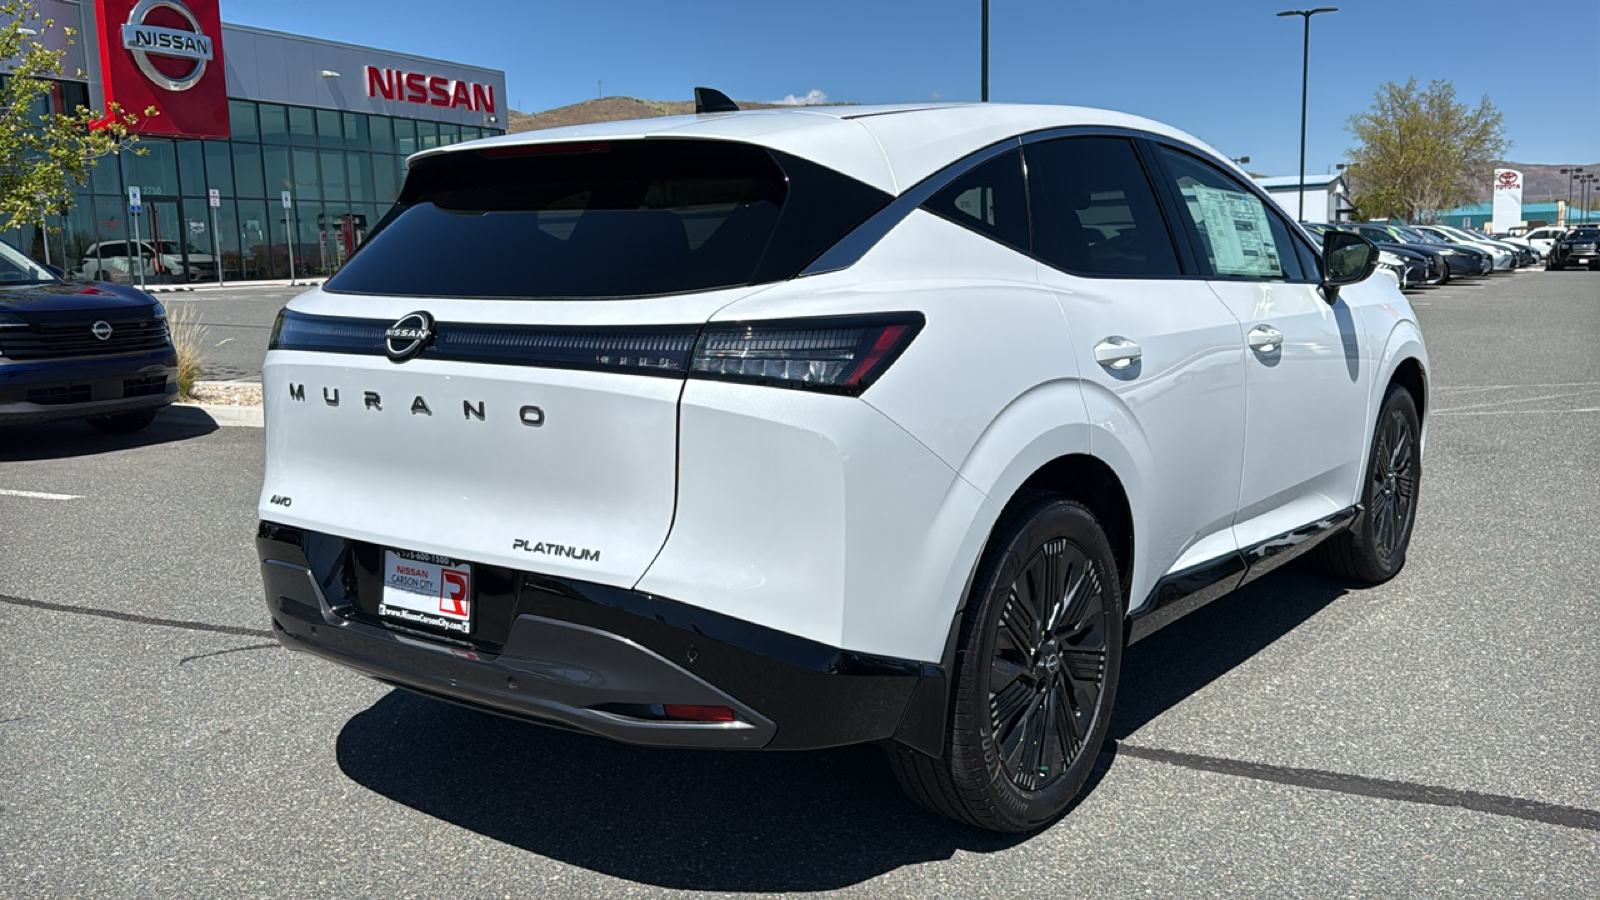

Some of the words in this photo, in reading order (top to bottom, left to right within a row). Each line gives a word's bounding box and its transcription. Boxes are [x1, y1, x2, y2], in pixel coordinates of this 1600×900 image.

[135, 29, 209, 55] NISSAN
[367, 66, 495, 113] NISSAN
[385, 329, 429, 338] NISSAN
[289, 382, 545, 427] MURANO
[269, 494, 293, 508] AWD
[511, 538, 601, 562] PLATINUM
[391, 574, 418, 587] CARSON
[419, 579, 434, 590] CITY
[396, 565, 429, 579] NISSAN
[385, 608, 462, 630] www.NissanCarsonCity.com
